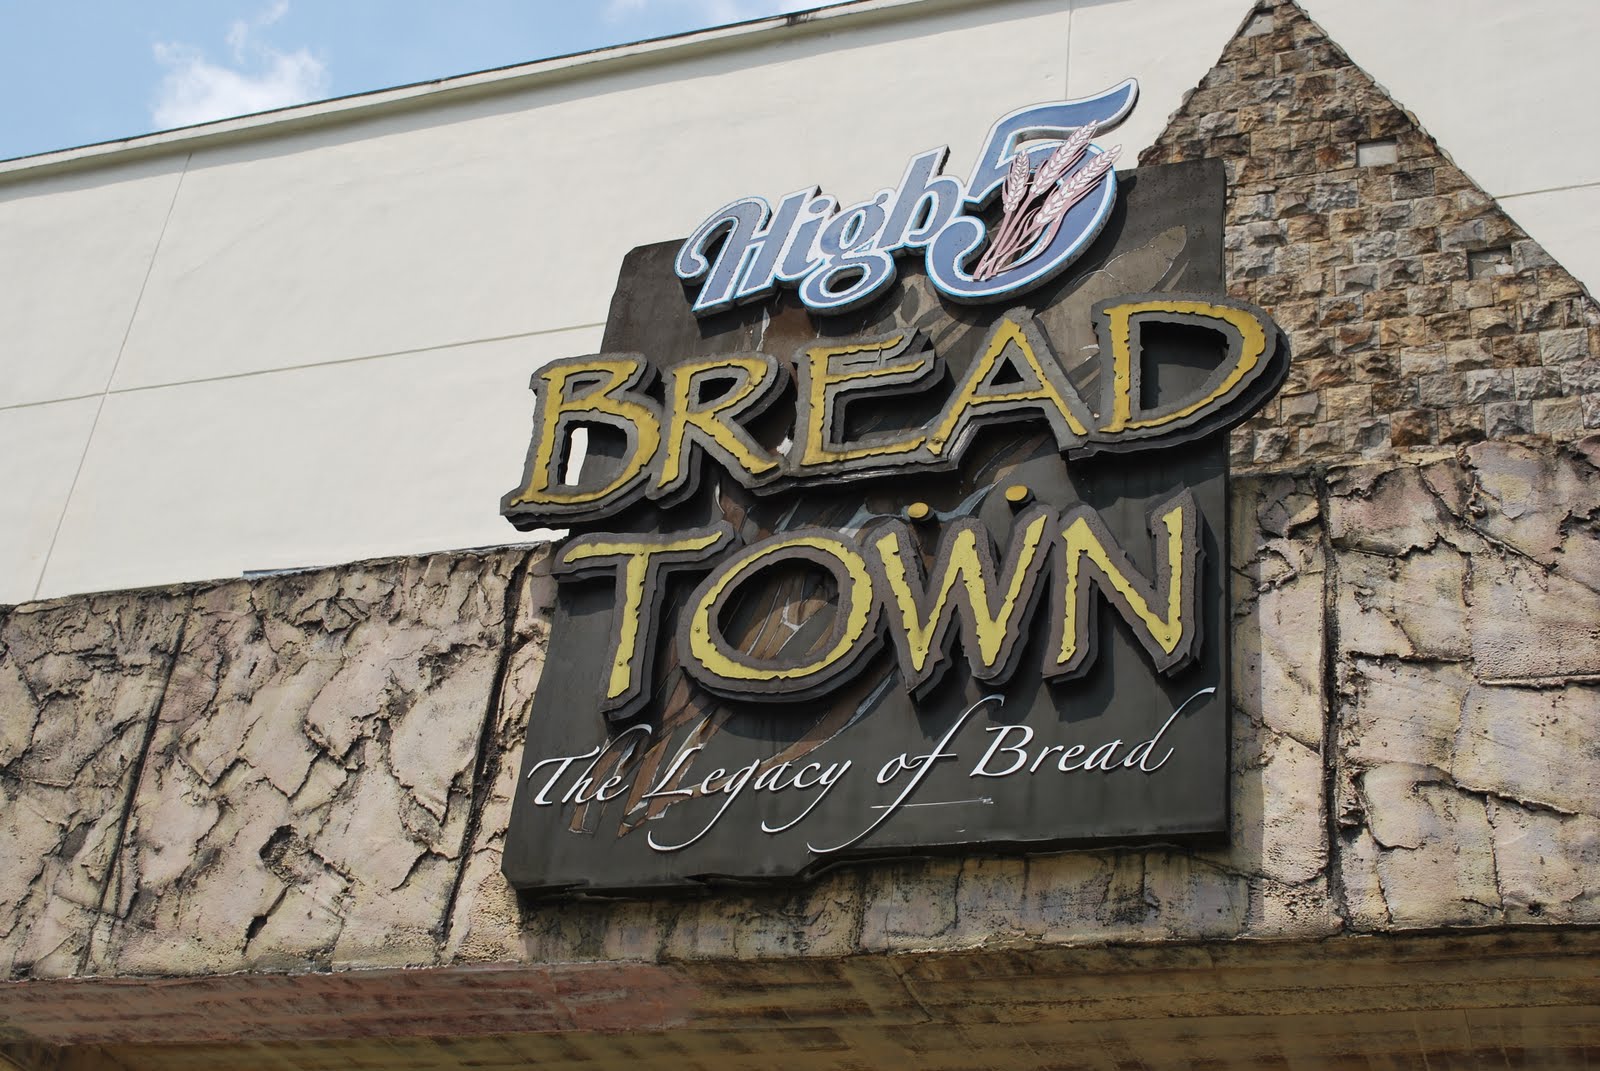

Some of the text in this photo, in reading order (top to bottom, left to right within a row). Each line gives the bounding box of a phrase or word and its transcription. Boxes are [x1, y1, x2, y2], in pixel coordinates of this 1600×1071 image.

[674, 78, 1139, 315] High 5
[503, 294, 1284, 522] BREAD
[555, 489, 1196, 712] TOWN
[528, 687, 1215, 854] The Legacy of Bread
